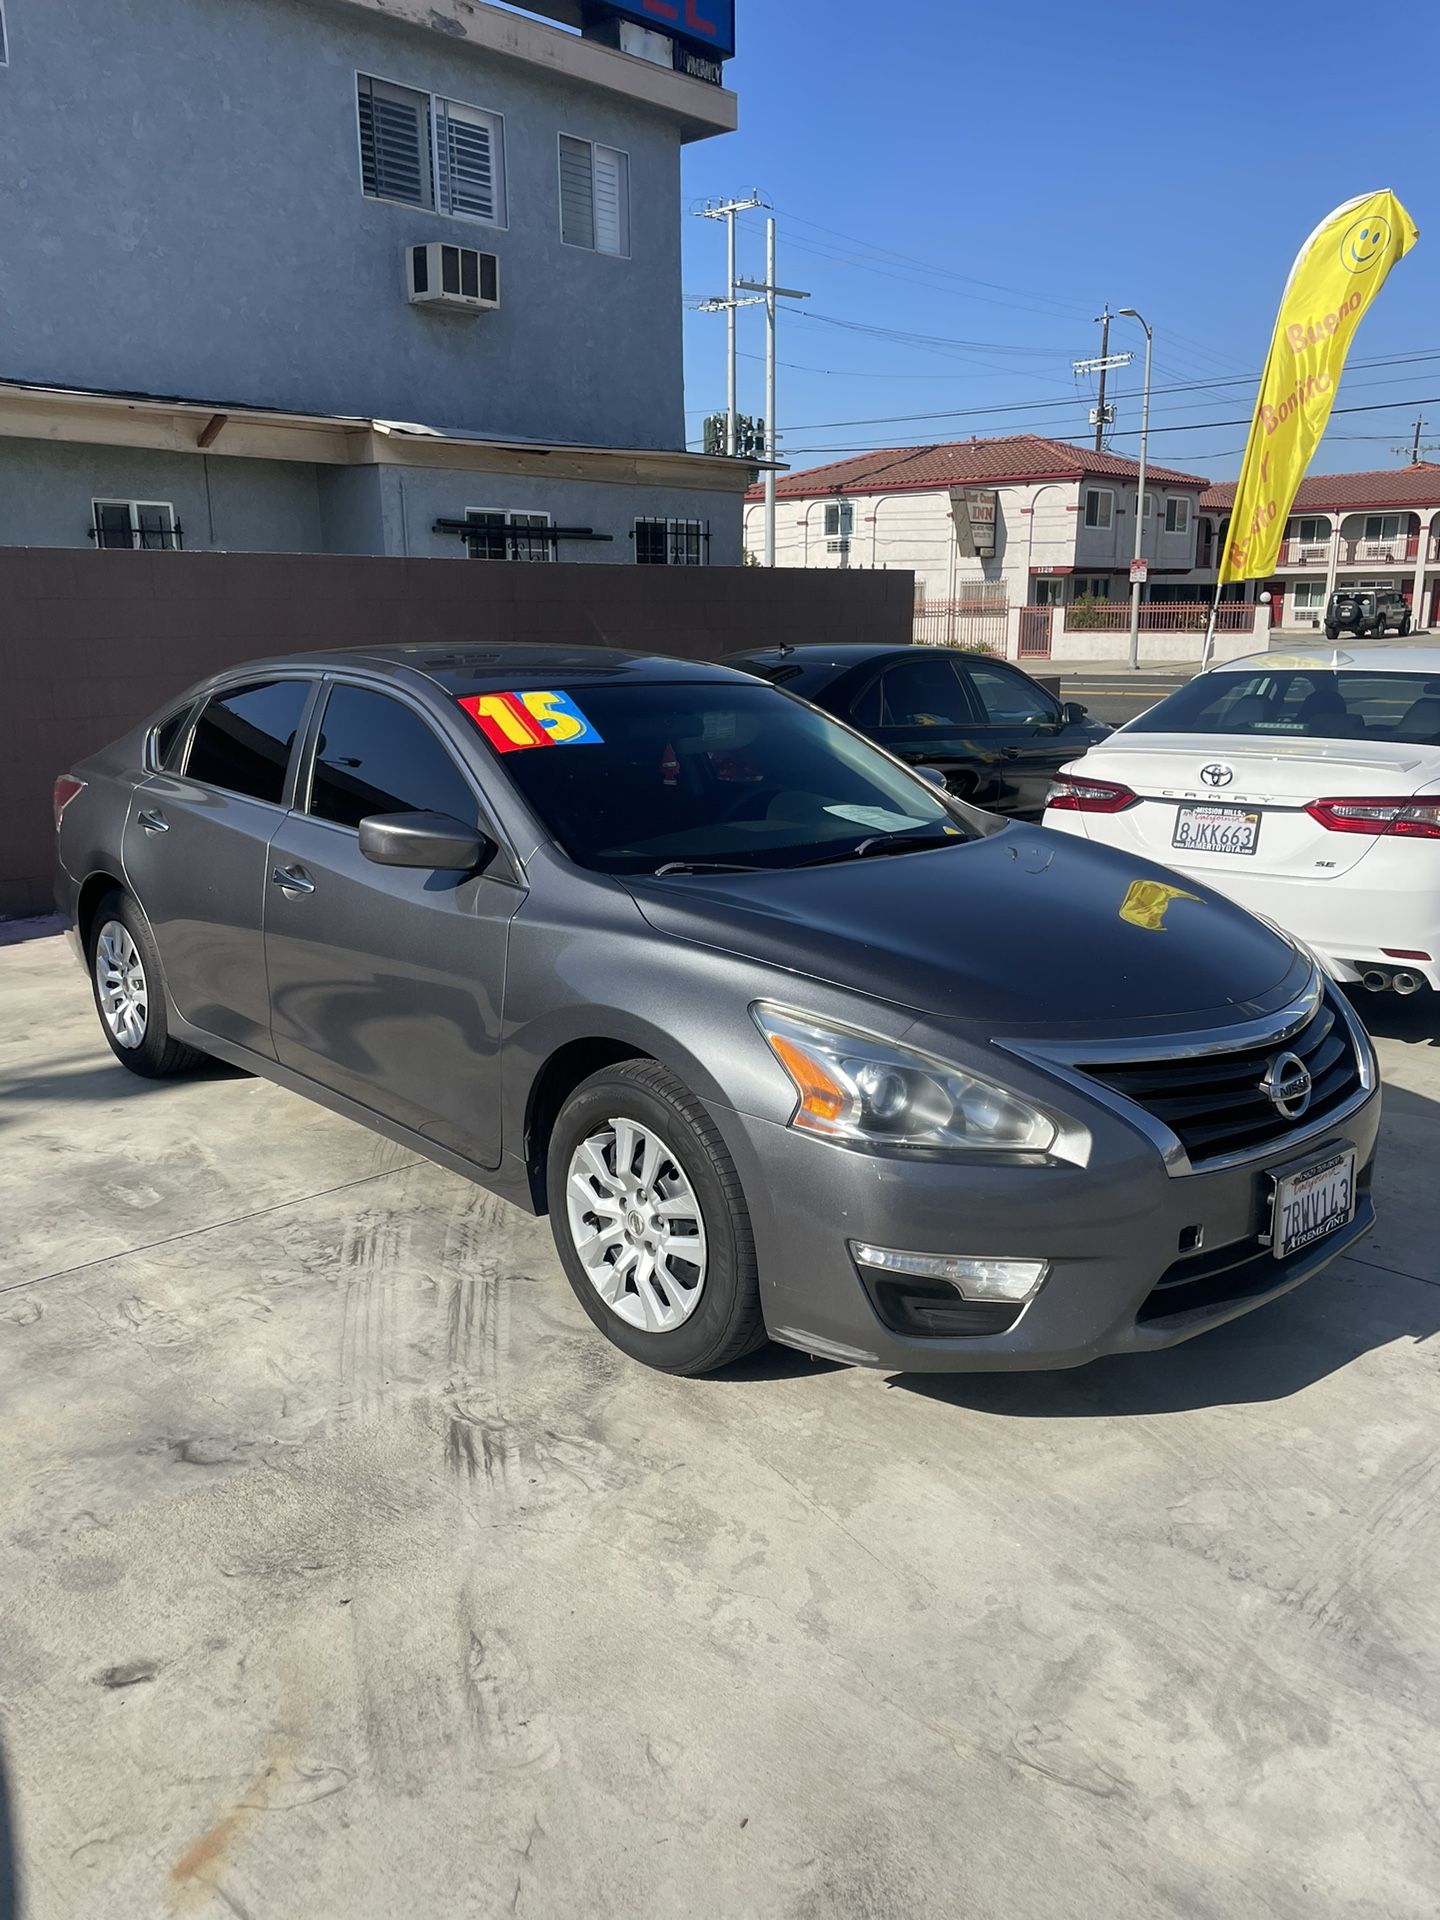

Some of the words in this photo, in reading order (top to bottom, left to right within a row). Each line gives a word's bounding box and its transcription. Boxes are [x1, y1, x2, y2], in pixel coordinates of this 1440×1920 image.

[1287, 291, 1362, 354] Bueno
[1260, 371, 1331, 436] Bonito
[478, 692, 588, 746] 15
[1162, 790, 1276, 803] CAMRY
[1196, 807, 1223, 816] MISSION
[1223, 809, 1242, 817] HILLS
[1180, 823, 1252, 847] 8JKK663
[1283, 1179, 1349, 1242] 7RWV143
